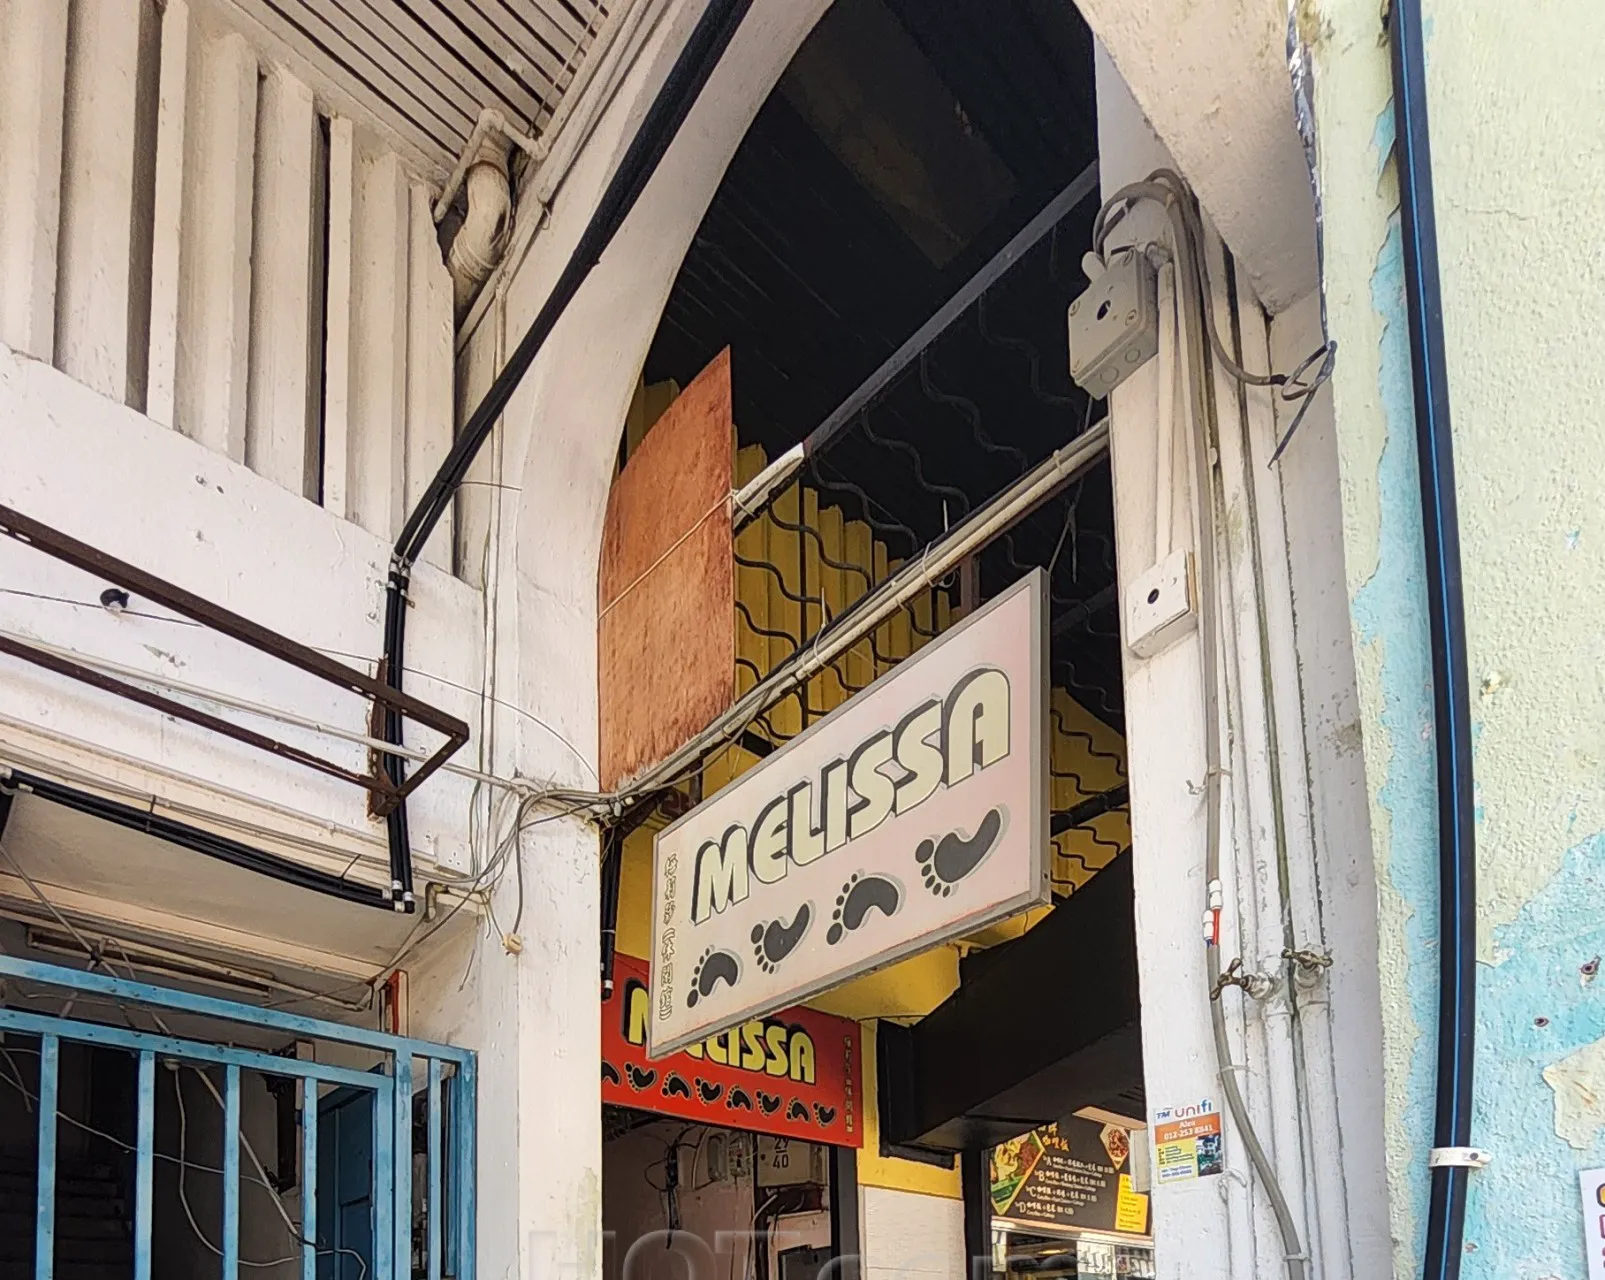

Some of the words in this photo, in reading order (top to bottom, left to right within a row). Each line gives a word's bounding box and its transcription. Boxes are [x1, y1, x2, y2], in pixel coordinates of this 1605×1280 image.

[690, 667, 1011, 926] MELISSA
[621, 978, 817, 1085] LISSA
[1156, 1110, 1171, 1119] TM
[1175, 1099, 1212, 1118] unifi
[773, 1154, 789, 1169] 40
